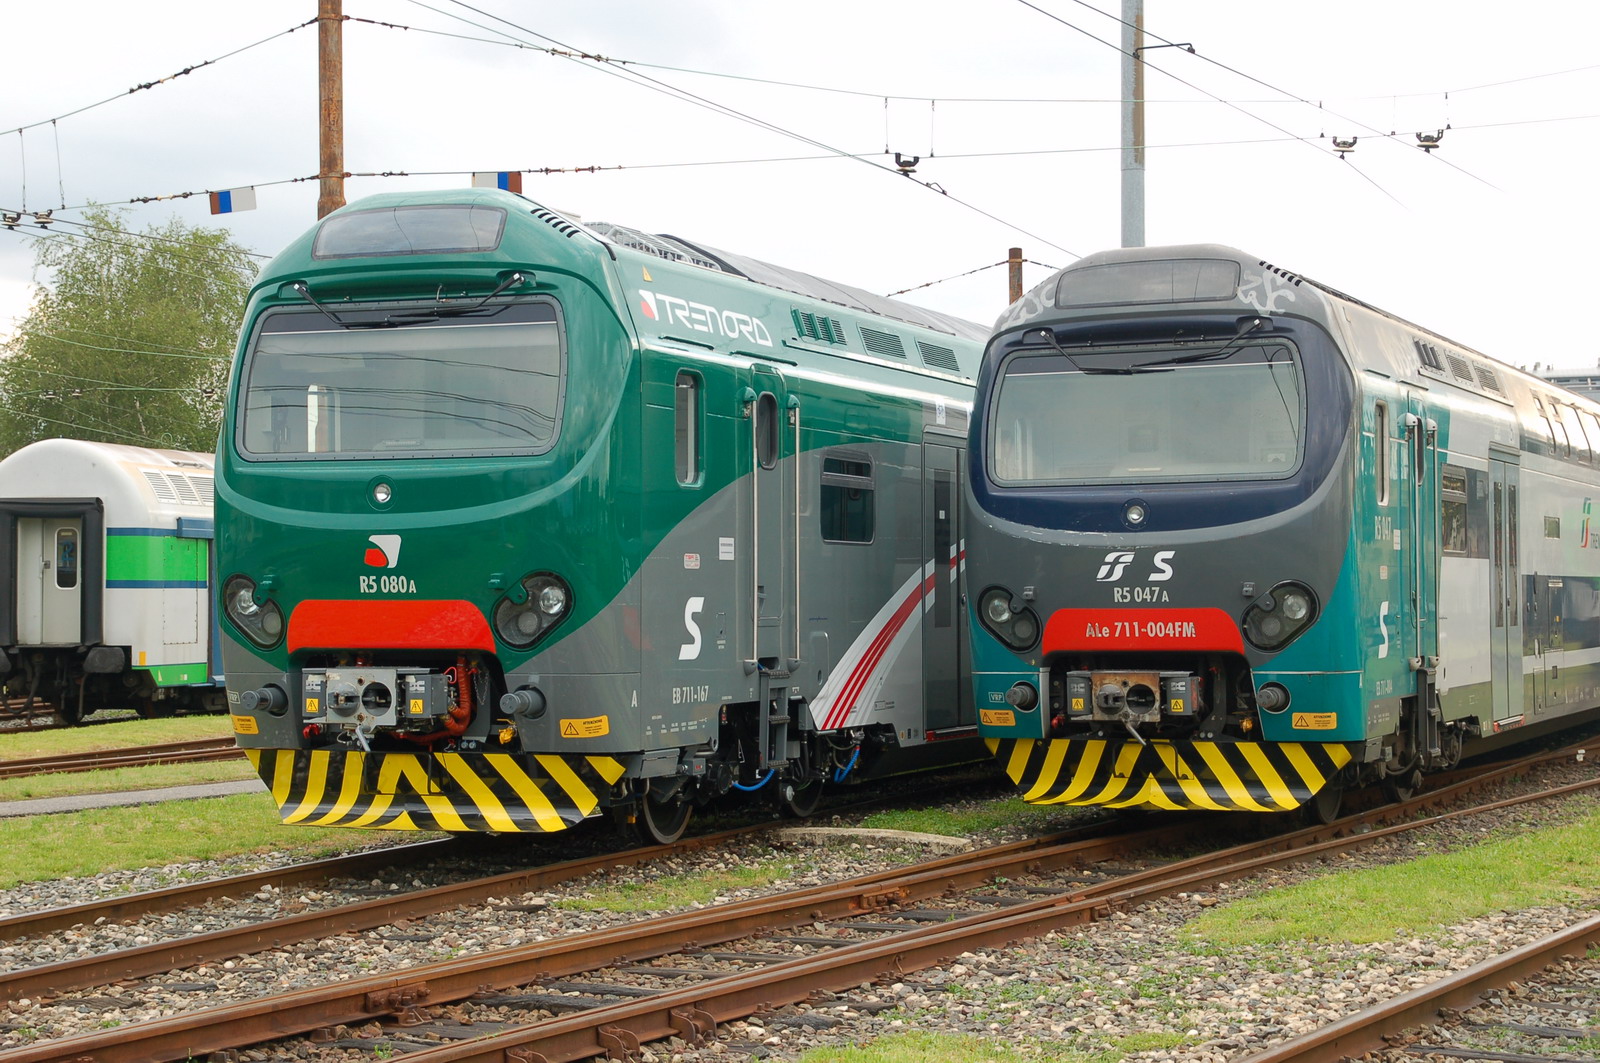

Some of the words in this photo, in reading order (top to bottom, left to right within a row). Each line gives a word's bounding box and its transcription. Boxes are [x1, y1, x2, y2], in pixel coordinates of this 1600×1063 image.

[655, 292, 773, 347] TRENORD
[1147, 550, 1176, 581] S
[359, 575, 378, 594] R5
[380, 575, 408, 594] 080
[408, 579, 417, 594] A
[1113, 587, 1131, 603] R5
[1134, 587, 1160, 603] 047
[1161, 590, 1170, 603] A
[679, 596, 705, 661] S
[1086, 622, 1110, 638] ALe
[1114, 621, 1197, 638] 711-004FM
[631, 689, 638, 708] A
[673, 687, 682, 705] EB
[682, 684, 709, 704] 711-167
